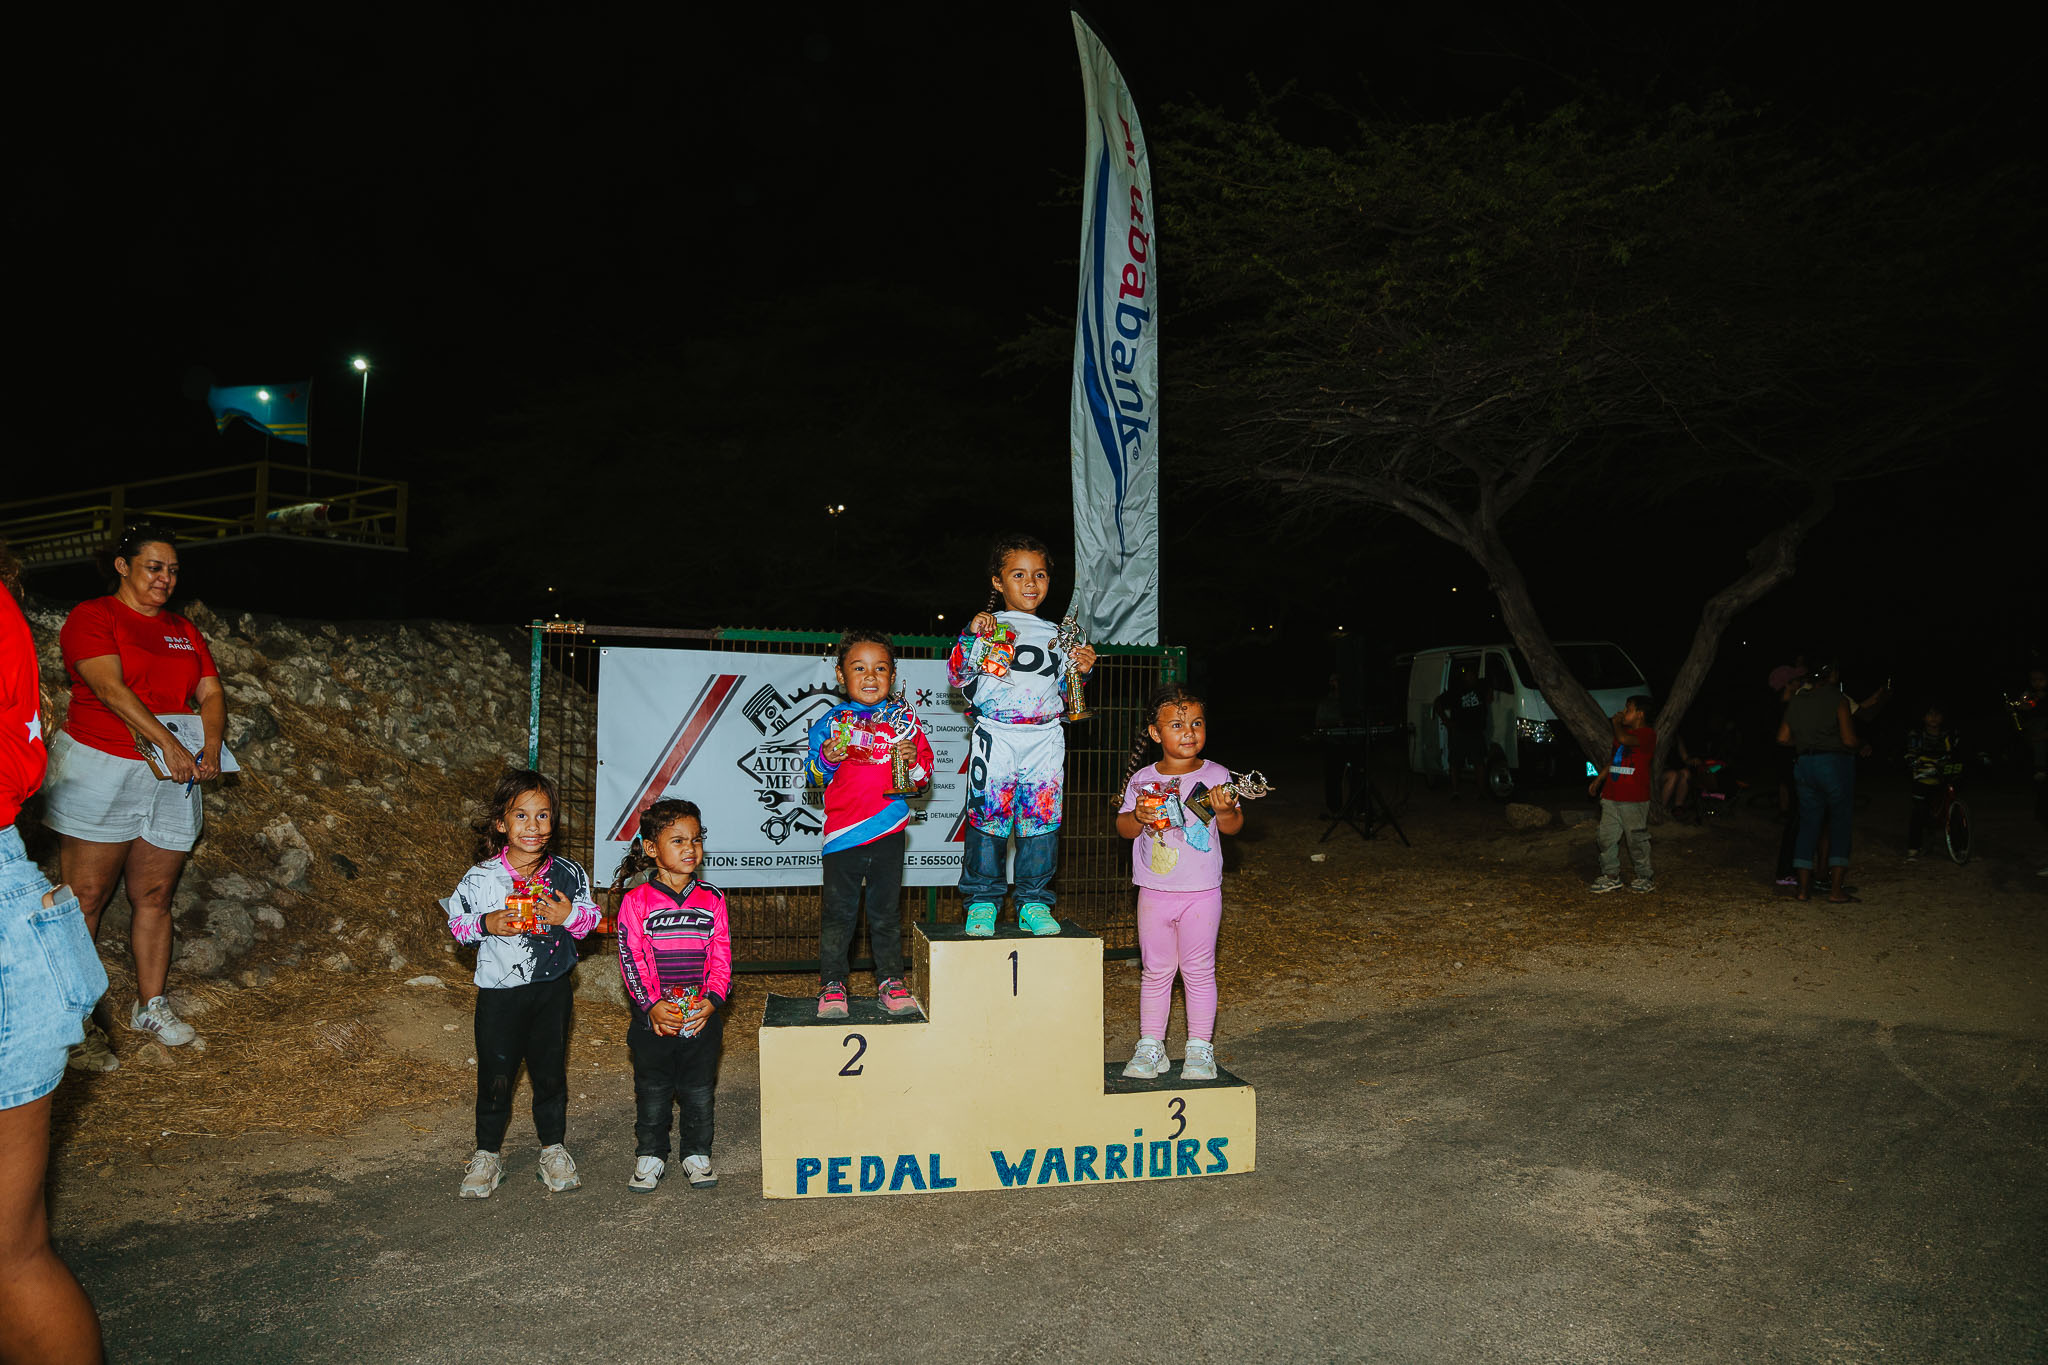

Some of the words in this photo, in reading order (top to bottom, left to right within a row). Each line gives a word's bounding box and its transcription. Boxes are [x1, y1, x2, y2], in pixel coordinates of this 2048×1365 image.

[1010, 644, 1062, 680] OX
[740, 856, 773, 866] SERO
[776, 855, 823, 866] PATRISH
[652, 915, 710, 927] WULF
[1007, 950, 1019, 997] 1
[838, 1032, 869, 1077] 2
[1167, 1097, 1187, 1140] 3
[796, 1152, 957, 1195] PEDAL
